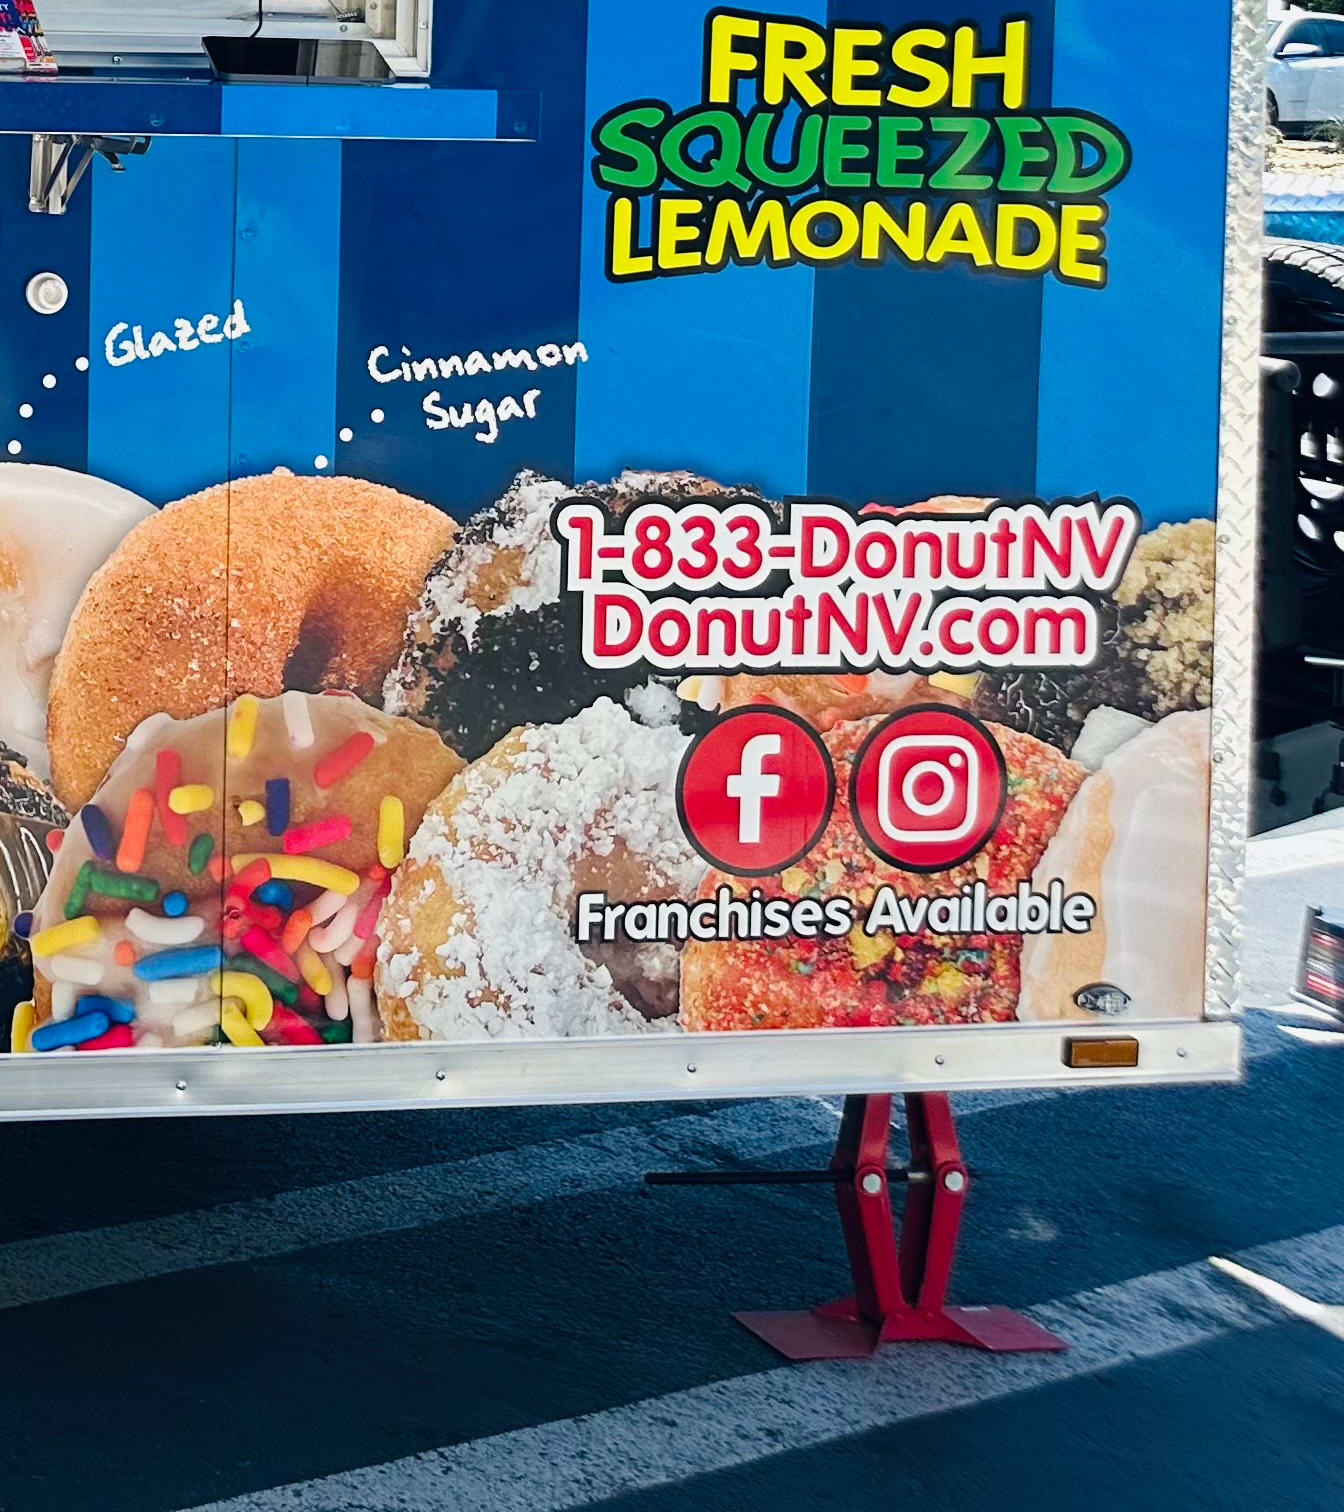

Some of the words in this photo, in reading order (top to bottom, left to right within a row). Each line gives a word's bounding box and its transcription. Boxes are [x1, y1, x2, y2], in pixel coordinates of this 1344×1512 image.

[709, 14, 1029, 109] FRESH
[598, 106, 1124, 194] SQUEEZED
[611, 197, 1106, 282] LEMONADE
[104, 300, 251, 367] Glazed
[367, 336, 589, 386] Cinnamon
[421, 388, 543, 443] Sugar
[568, 515, 1124, 580] 1-833-DonutNV
[592, 594, 1086, 657] DonutNV.com
[576, 892, 851, 942] Franchises
[865, 881, 1096, 934] Available
